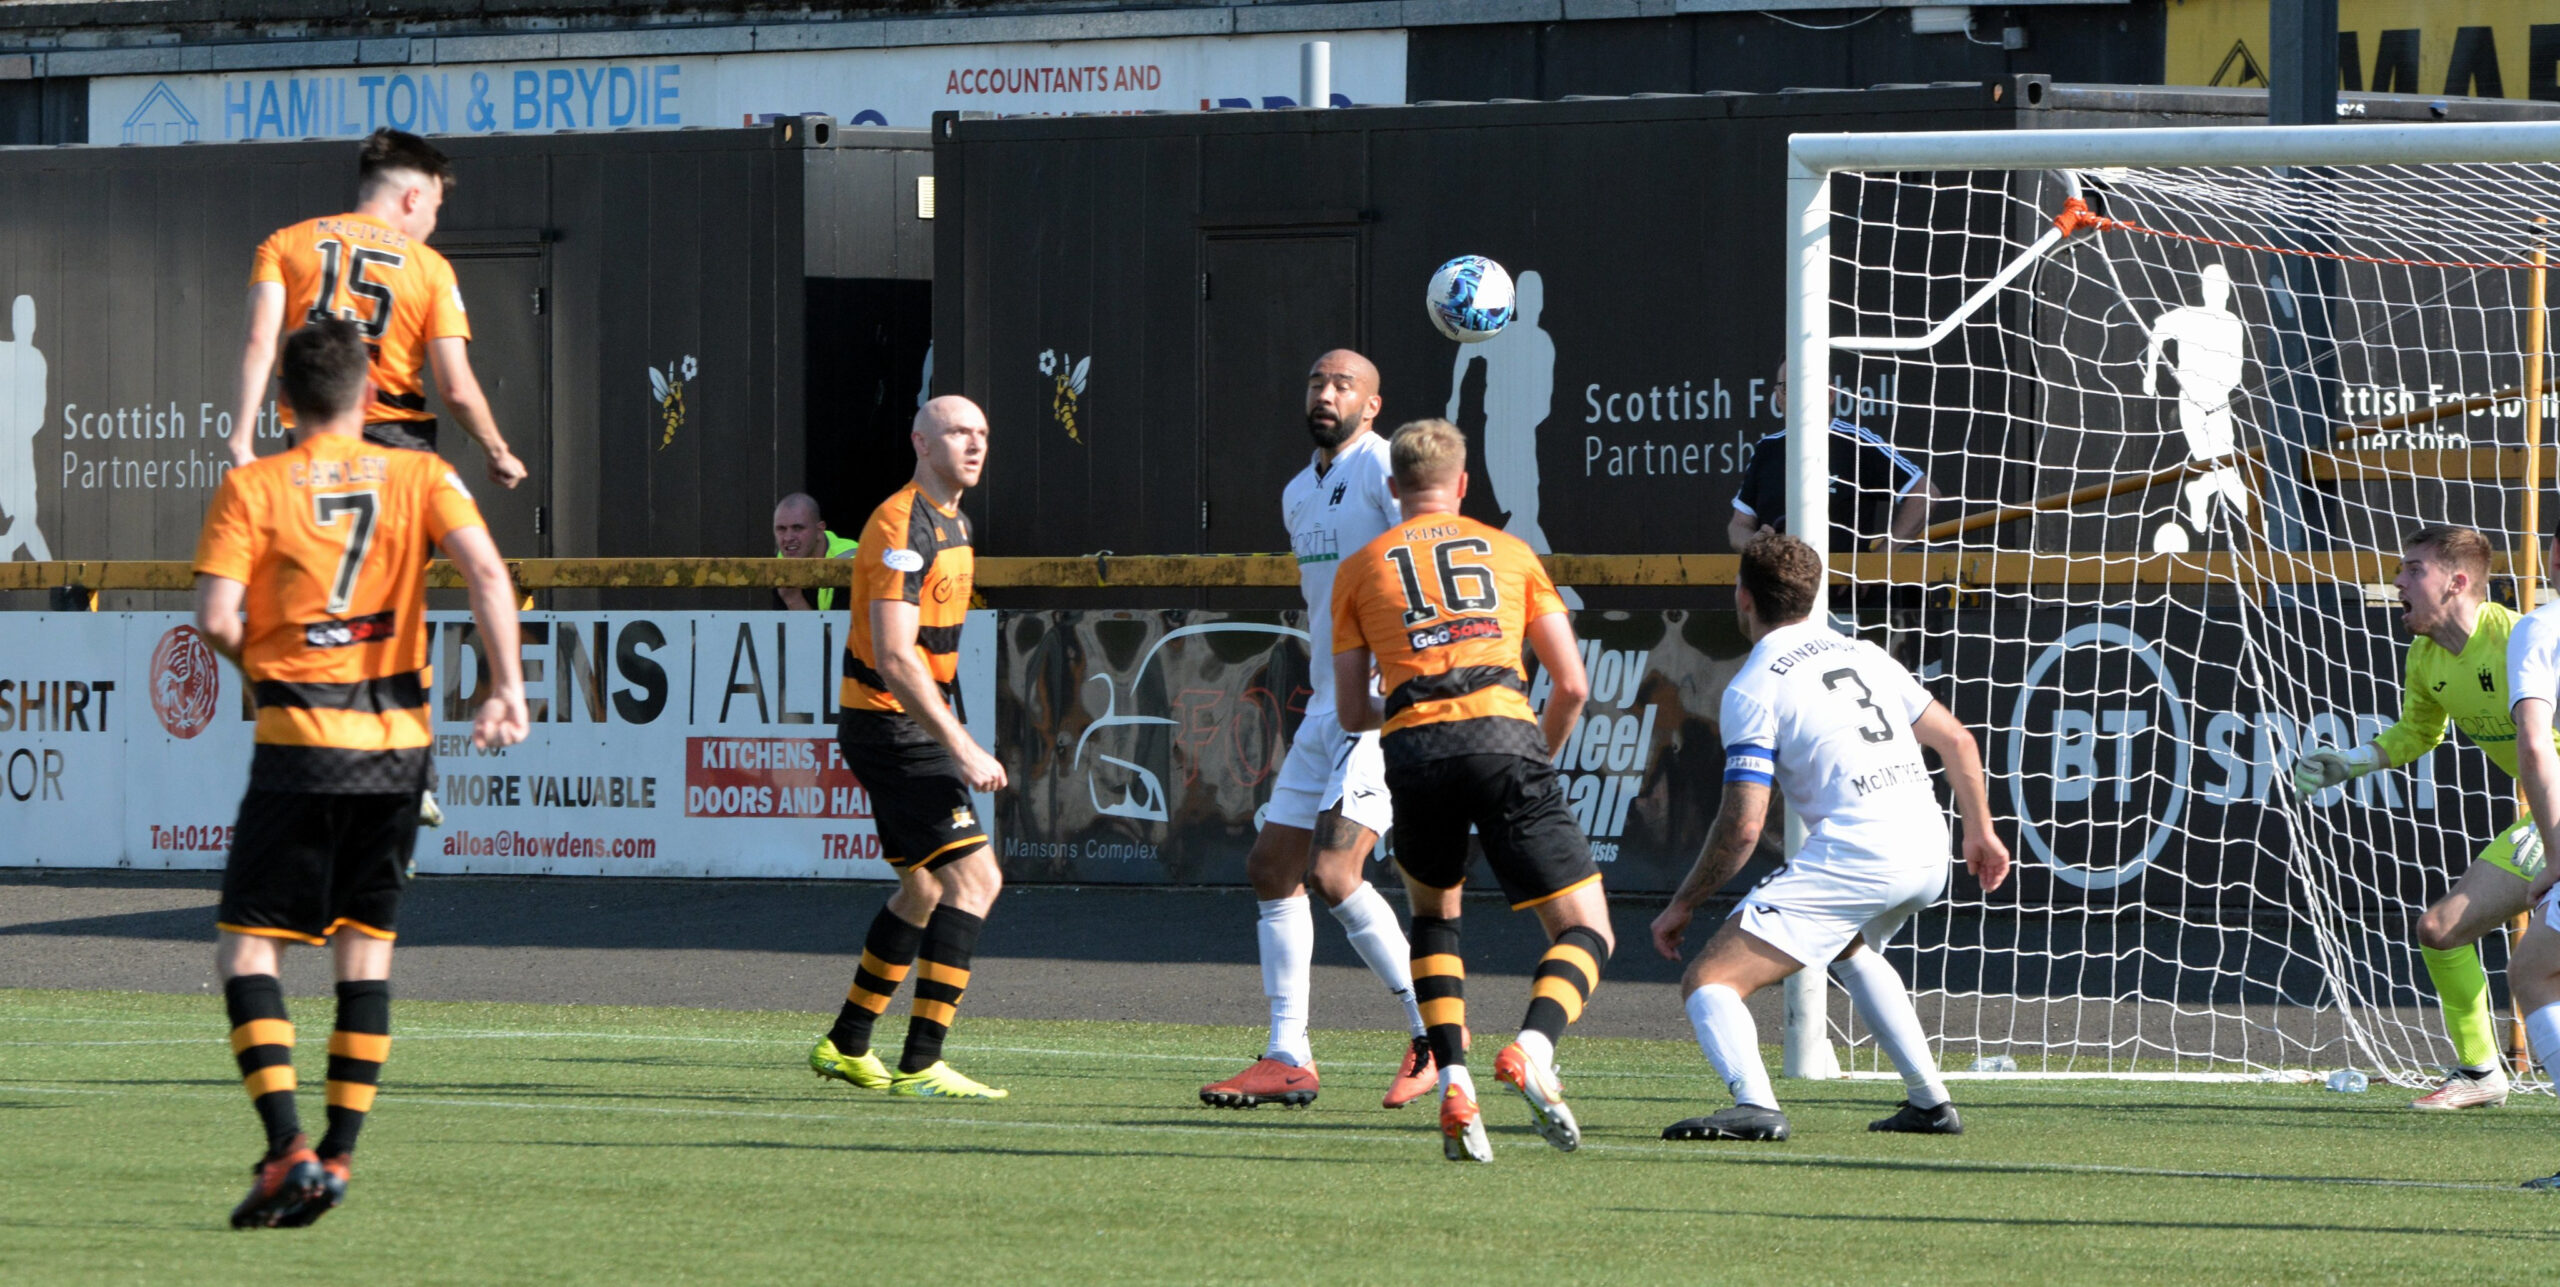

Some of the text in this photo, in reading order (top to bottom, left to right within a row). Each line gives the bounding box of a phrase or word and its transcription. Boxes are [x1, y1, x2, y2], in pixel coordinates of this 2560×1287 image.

[945, 65, 1161, 94] ACCOUNTANTS AND
[224, 65, 680, 138] HAMILTON & BRYDIE
[306, 239, 406, 339] 15
[1585, 373, 1897, 423] Scottish Foball
[2336, 383, 2416, 416] ttish
[63, 400, 285, 440] Scottish Fotb
[1586, 430, 1766, 477] Partnersh
[313, 489, 380, 613] 7
[1404, 525, 1459, 541] KING
[1384, 536, 1499, 628] 16
[1769, 638, 1859, 676] EDINBU
[0, 678, 115, 732] SHIRT
[1822, 667, 1894, 744] 3
[702, 742, 822, 776] KITCHENS,
[1537, 704, 1658, 772] heel
[2051, 709, 2148, 802] BT
[0, 748, 65, 801] OR
[447, 775, 521, 807] MORE
[528, 776, 656, 809] VALUABLE
[1852, 762, 1929, 797] McINTYR
[689, 786, 773, 815] DOORS
[778, 787, 825, 816] AND
[443, 830, 656, 859] alloa@howdens.com
[1005, 837, 1159, 864] Mansons Complex
